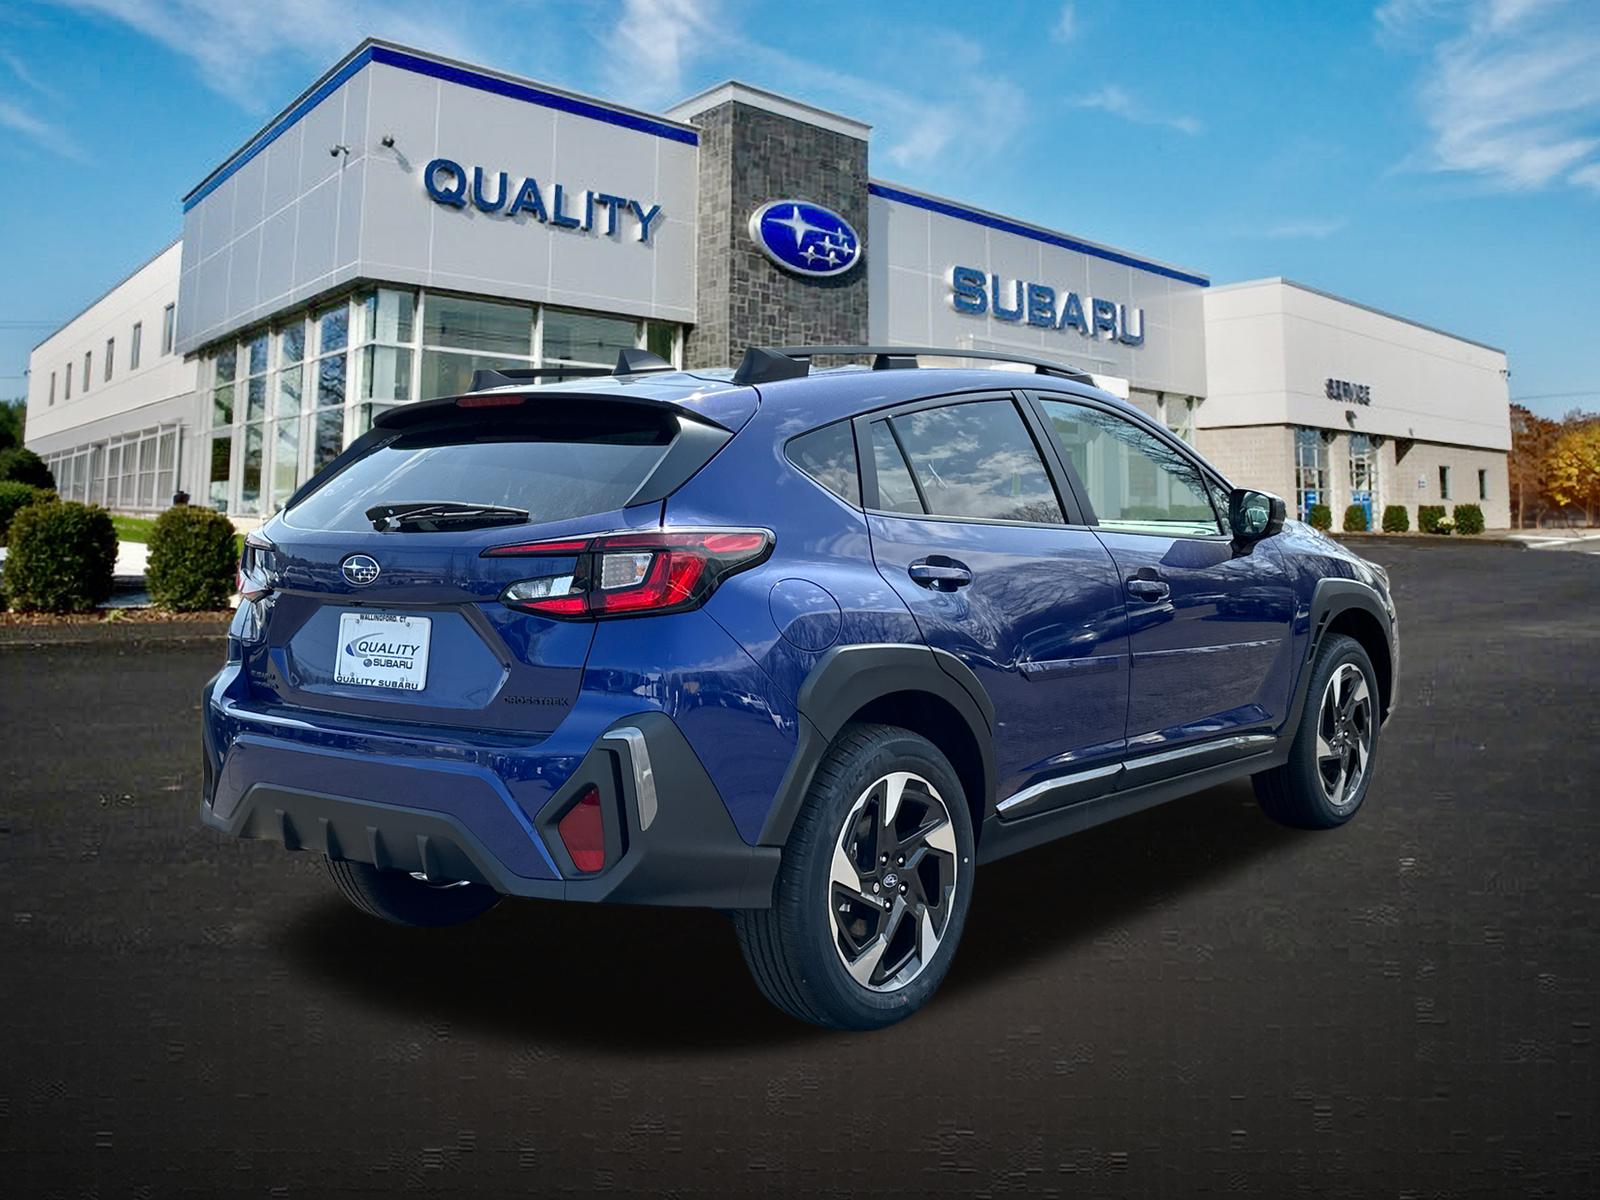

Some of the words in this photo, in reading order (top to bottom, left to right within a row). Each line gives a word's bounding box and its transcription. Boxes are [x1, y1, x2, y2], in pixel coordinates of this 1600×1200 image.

[423, 158, 662, 242] QUALITY
[951, 265, 1145, 346] SUBARU
[1325, 377, 1371, 407] SERVICE
[399, 615, 407, 623] CT
[358, 641, 420, 656] QUALITY
[373, 658, 413, 670] SUBARU
[336, 675, 376, 686] QUALITY
[378, 679, 418, 690] SUBARU
